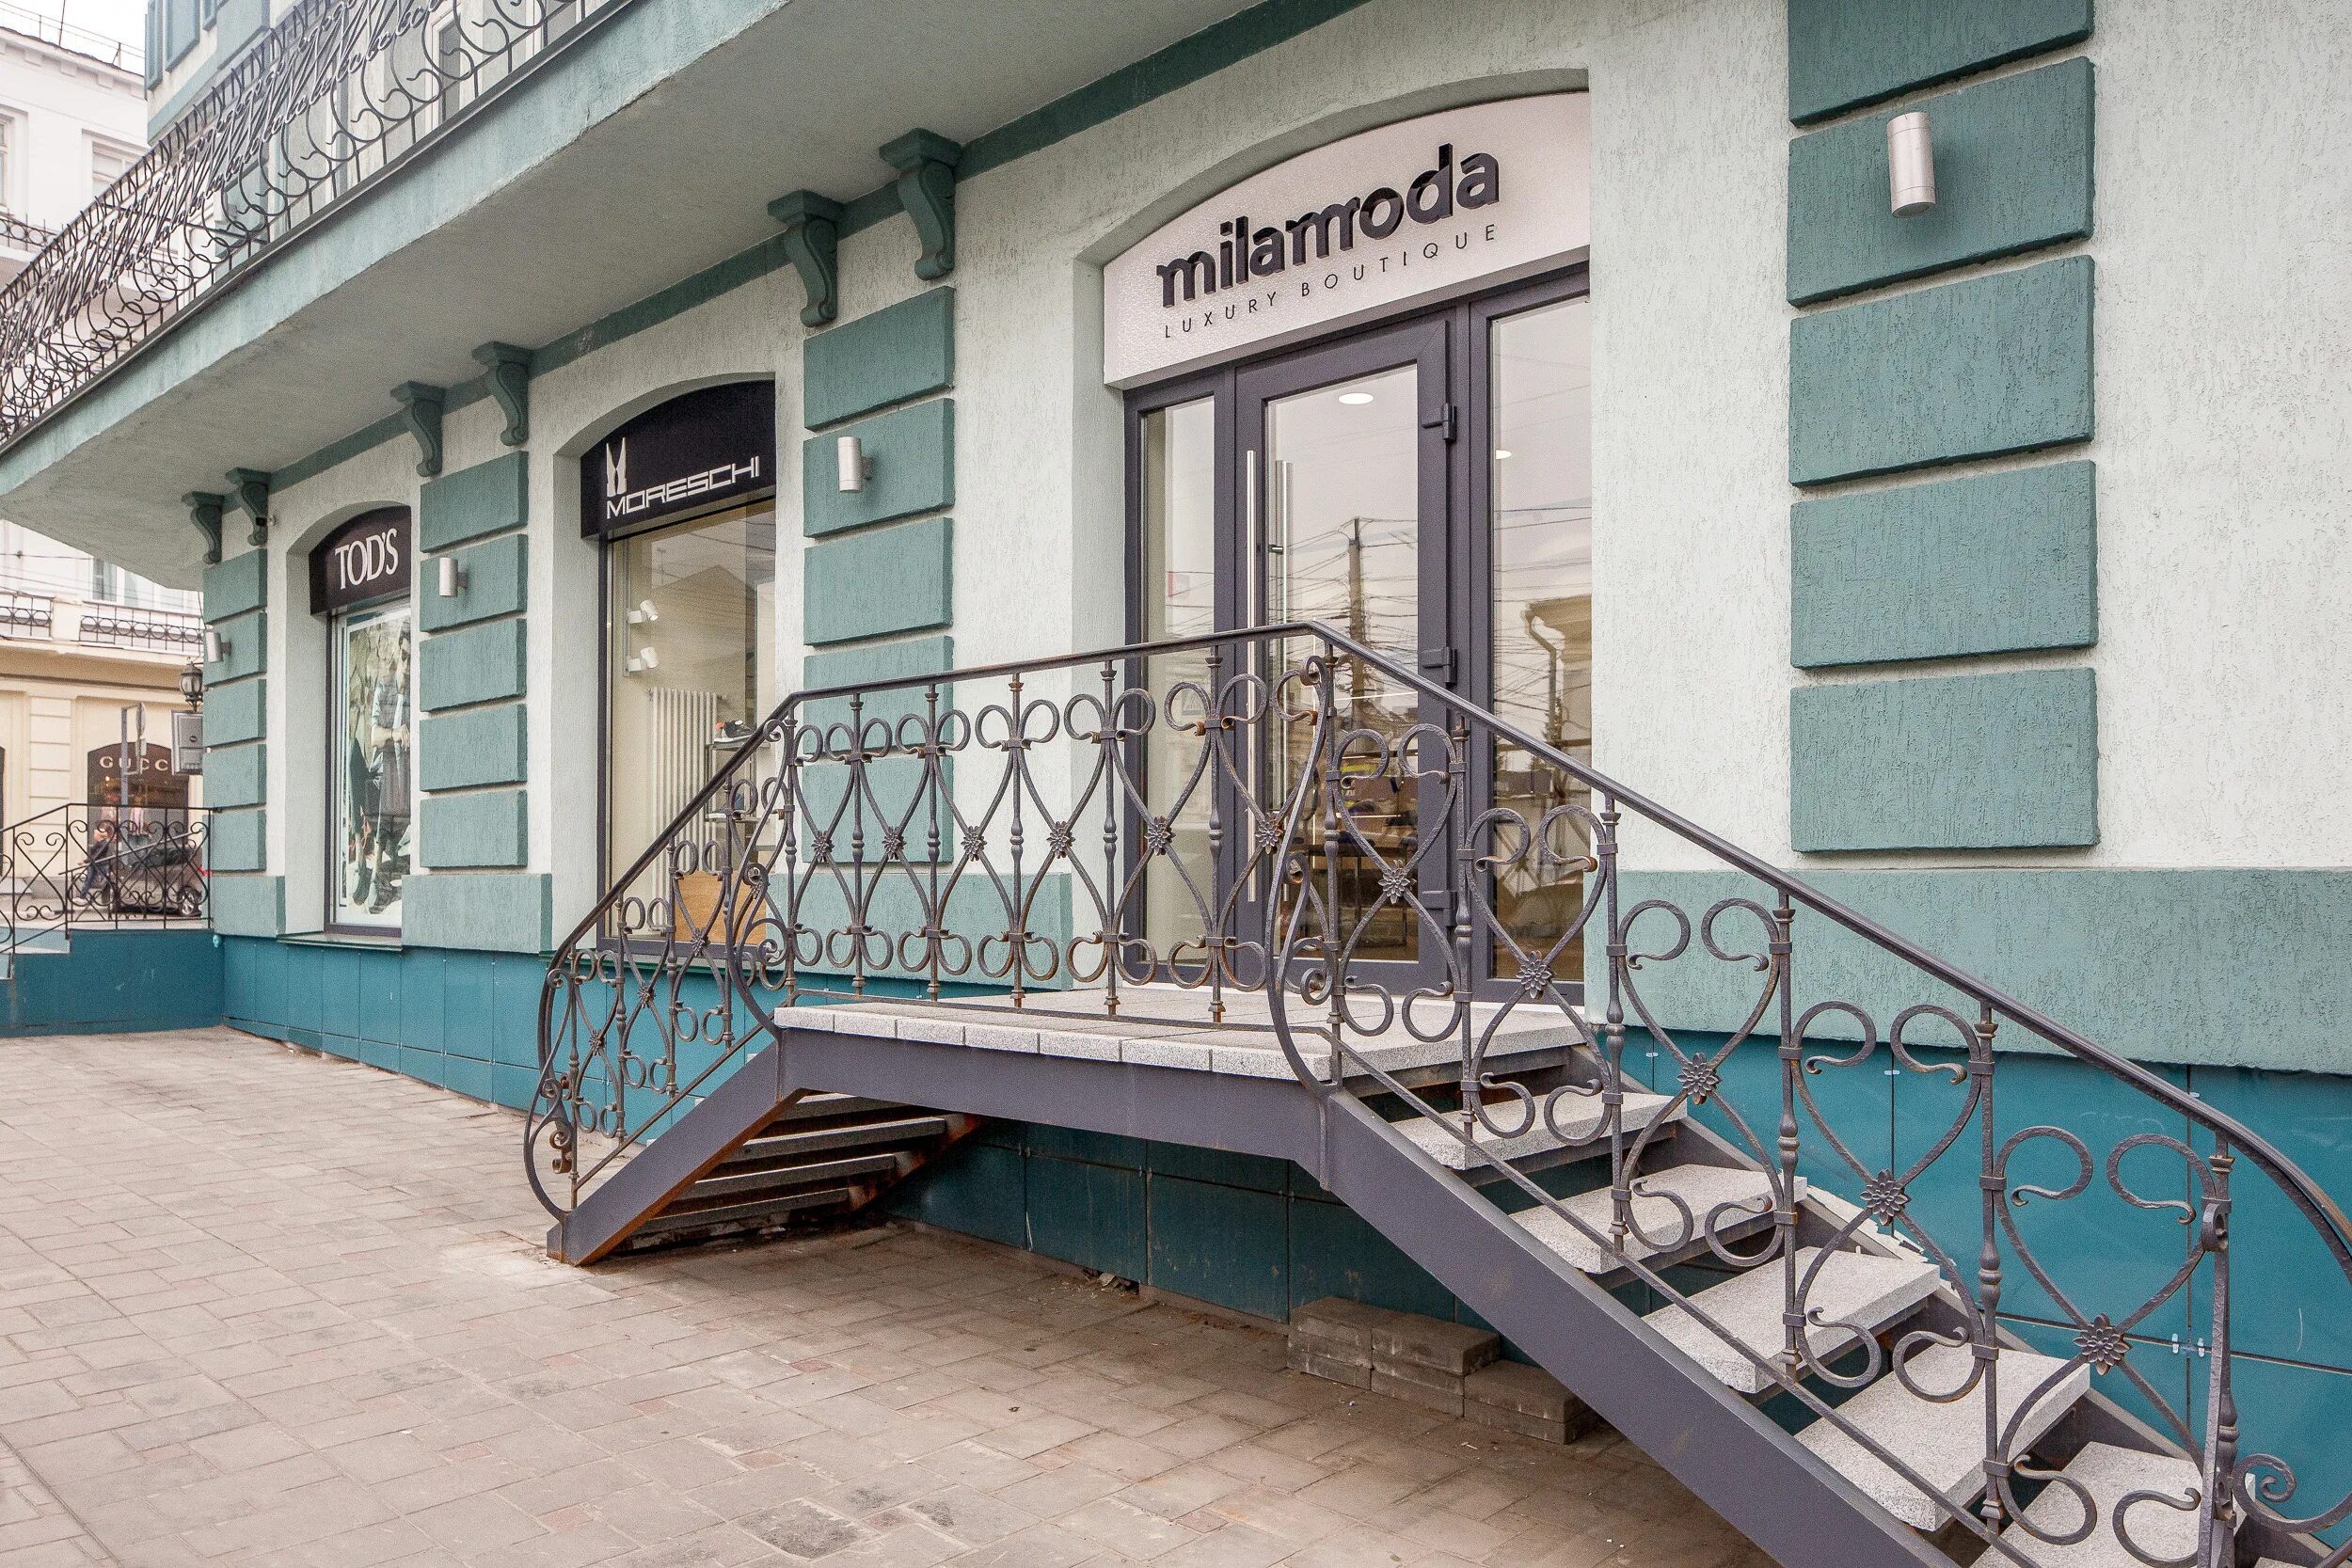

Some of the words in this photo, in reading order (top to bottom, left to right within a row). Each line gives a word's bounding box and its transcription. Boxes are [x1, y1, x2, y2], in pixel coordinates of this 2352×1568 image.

[1156, 143, 1500, 308] milamoda
[1165, 292, 1276, 338] LUXURY
[1302, 224, 1495, 296] BOUTIQUE
[606, 456, 760, 519] MORESCHI
[335, 528, 399, 590] TOD'S
[99, 755, 169, 771] GUCC
